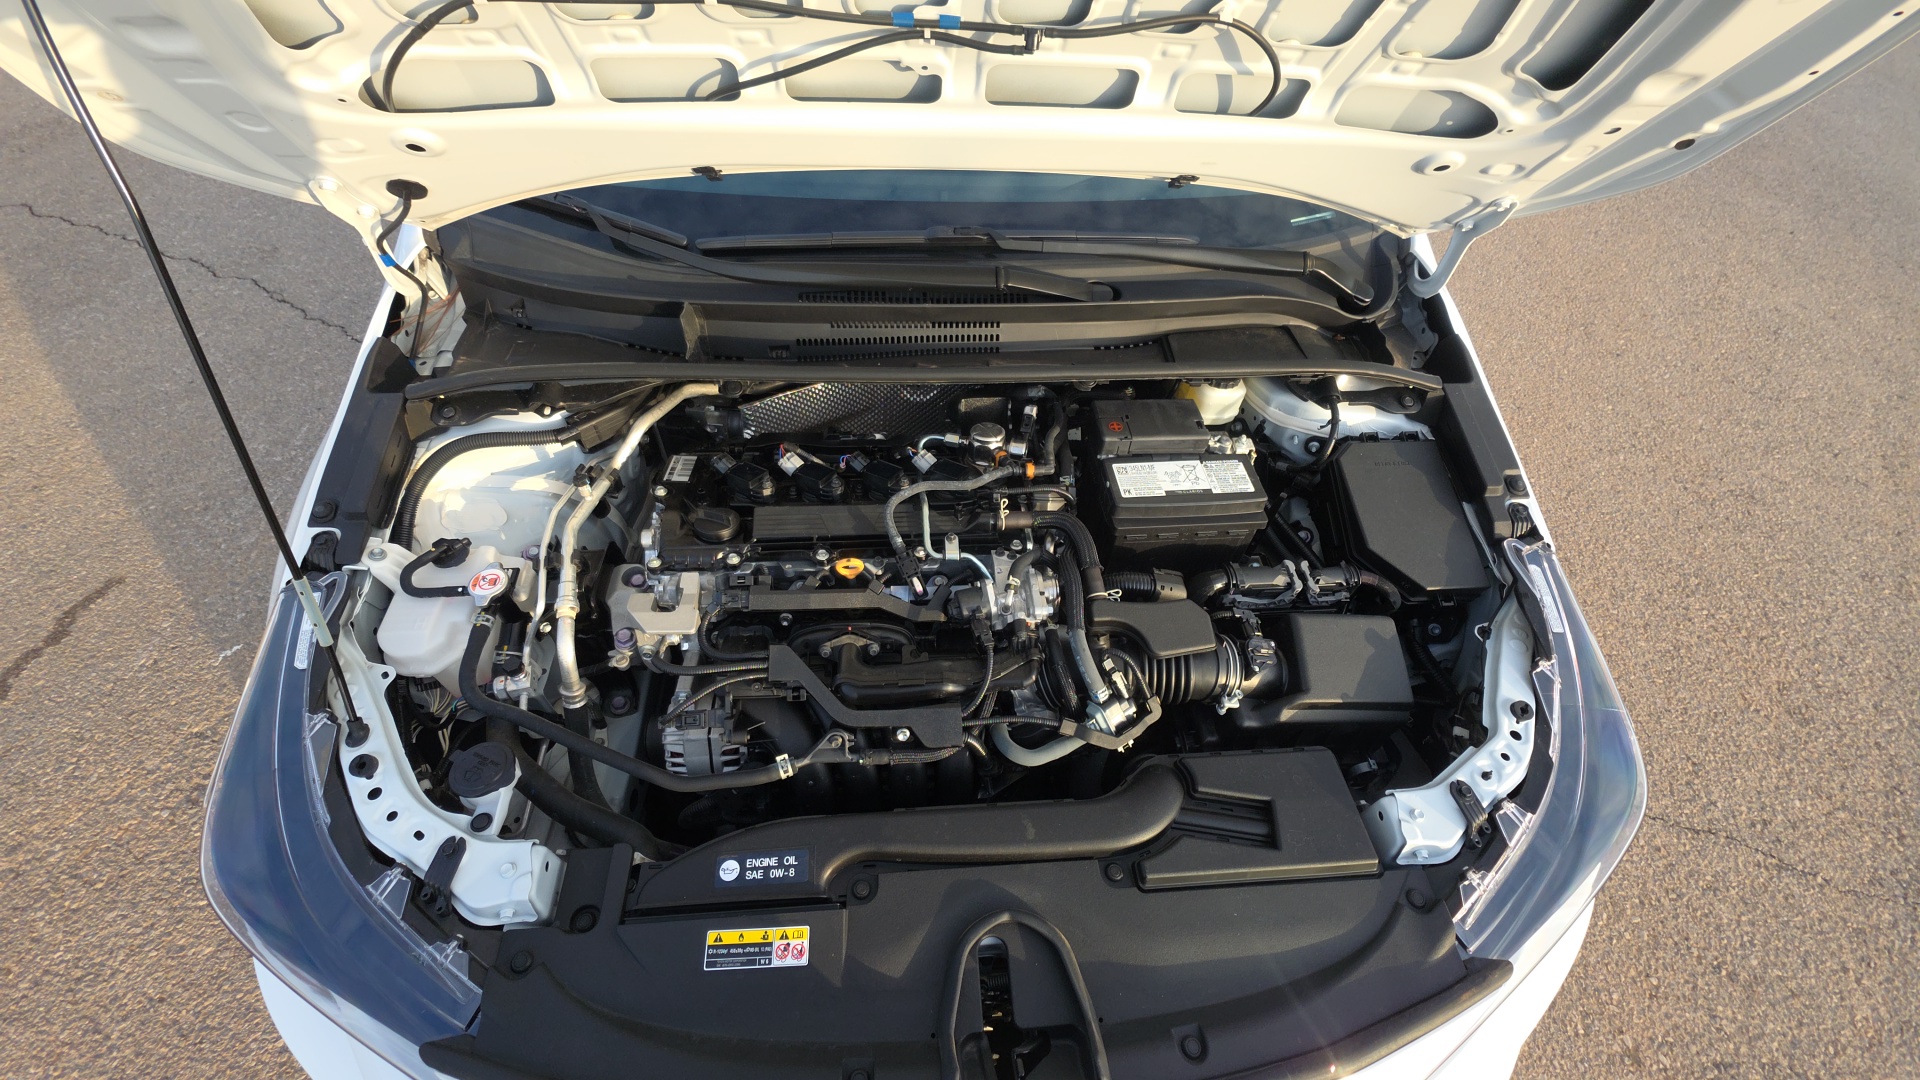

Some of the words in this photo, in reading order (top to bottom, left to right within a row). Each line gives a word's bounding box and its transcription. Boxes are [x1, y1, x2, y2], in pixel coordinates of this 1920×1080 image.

[746, 857, 779, 868] ENGINE
[783, 856, 798, 866] OIL
[745, 870, 764, 880] SAE
[769, 868, 795, 878] 0W-8
